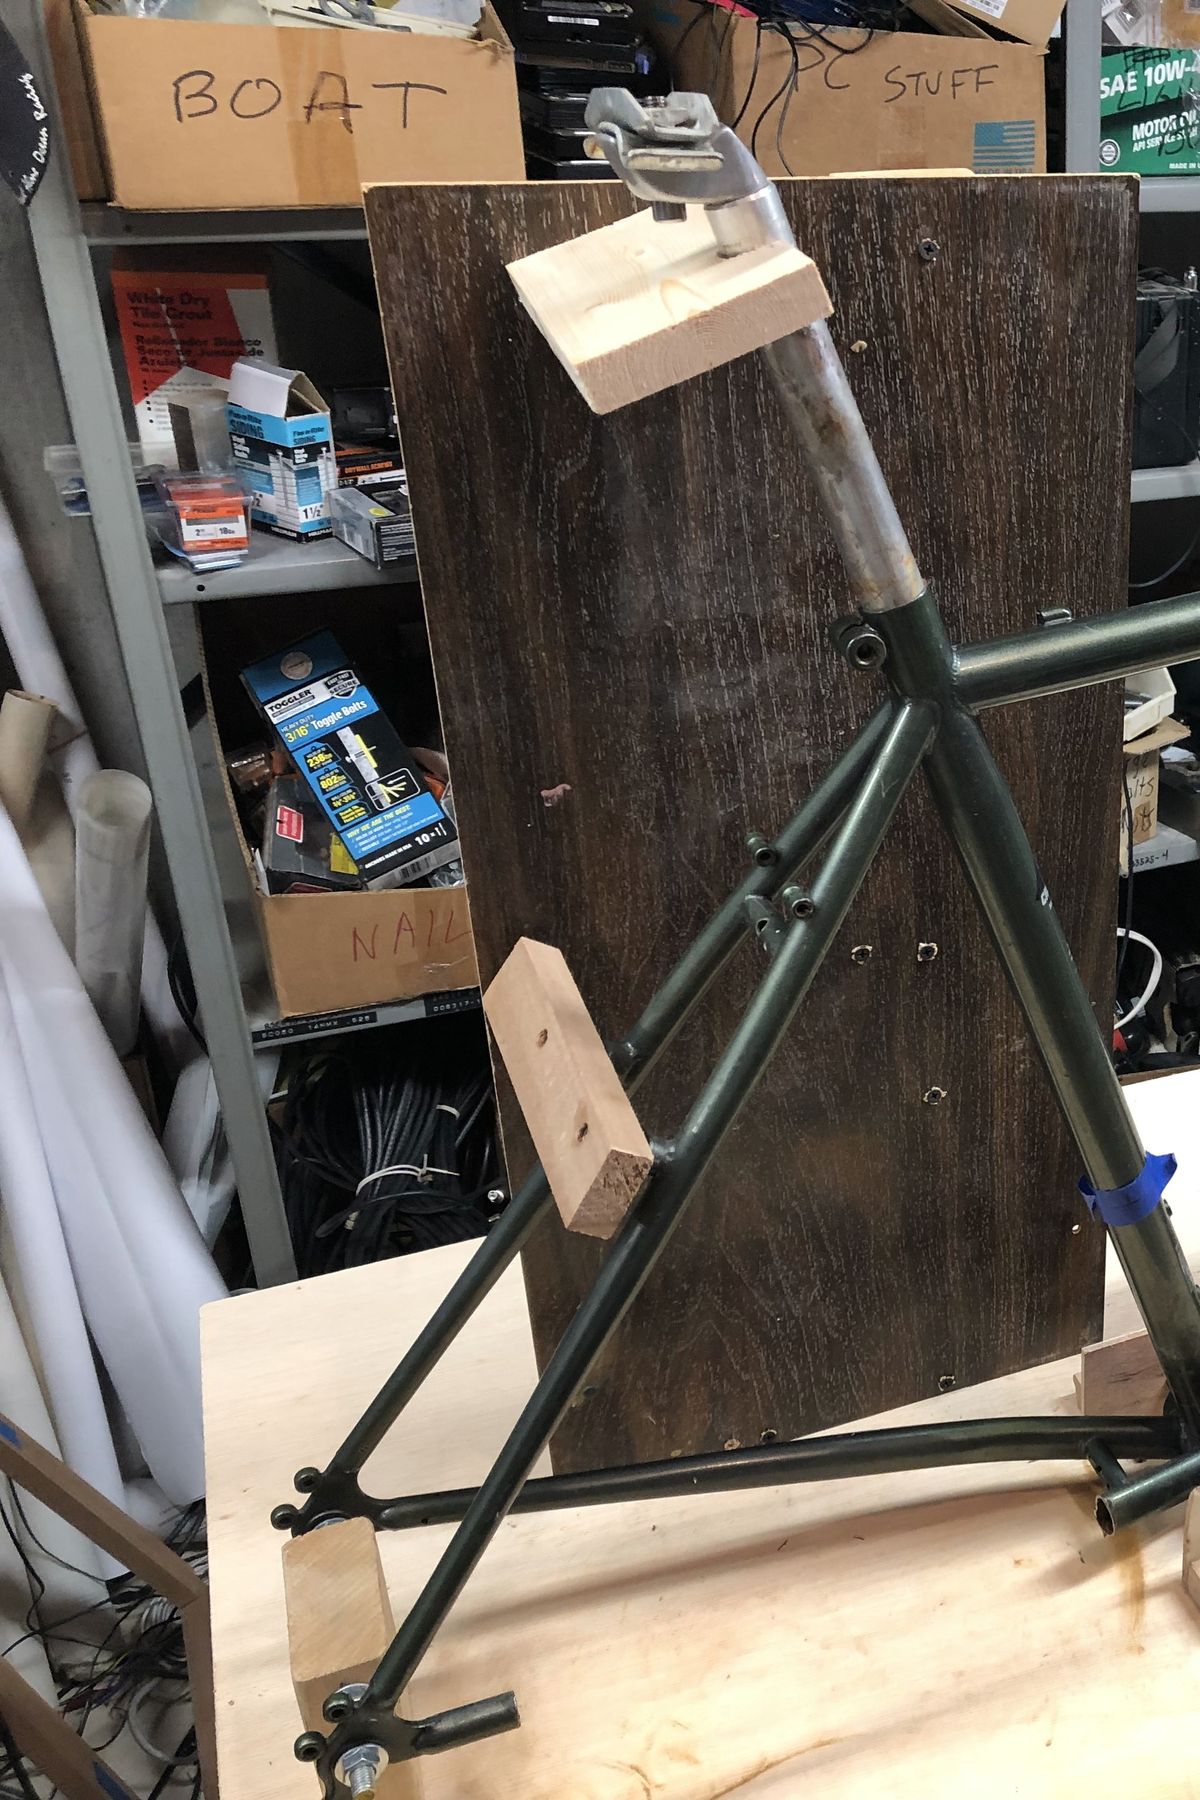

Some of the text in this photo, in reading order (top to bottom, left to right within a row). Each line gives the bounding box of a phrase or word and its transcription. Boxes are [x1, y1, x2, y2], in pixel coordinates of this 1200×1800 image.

[884, 64, 999, 103] STUFF
[1100, 70, 1138, 100] SAE
[172, 69, 447, 134] BOAT
[1131, 113, 1177, 141] MOTOR
[1168, 162, 1190, 170] MADE
[128, 290, 209, 307] White Dry
[166, 305, 213, 320] Grout
[229, 419, 264, 439] SIDING
[329, 679, 358, 695] SECURE
[268, 688, 313, 713] TOGGLER
[310, 711, 344, 731] Toggle
[340, 699, 368, 718] Bolts
[306, 753, 327, 768] 238
[320, 775, 339, 789] 802
